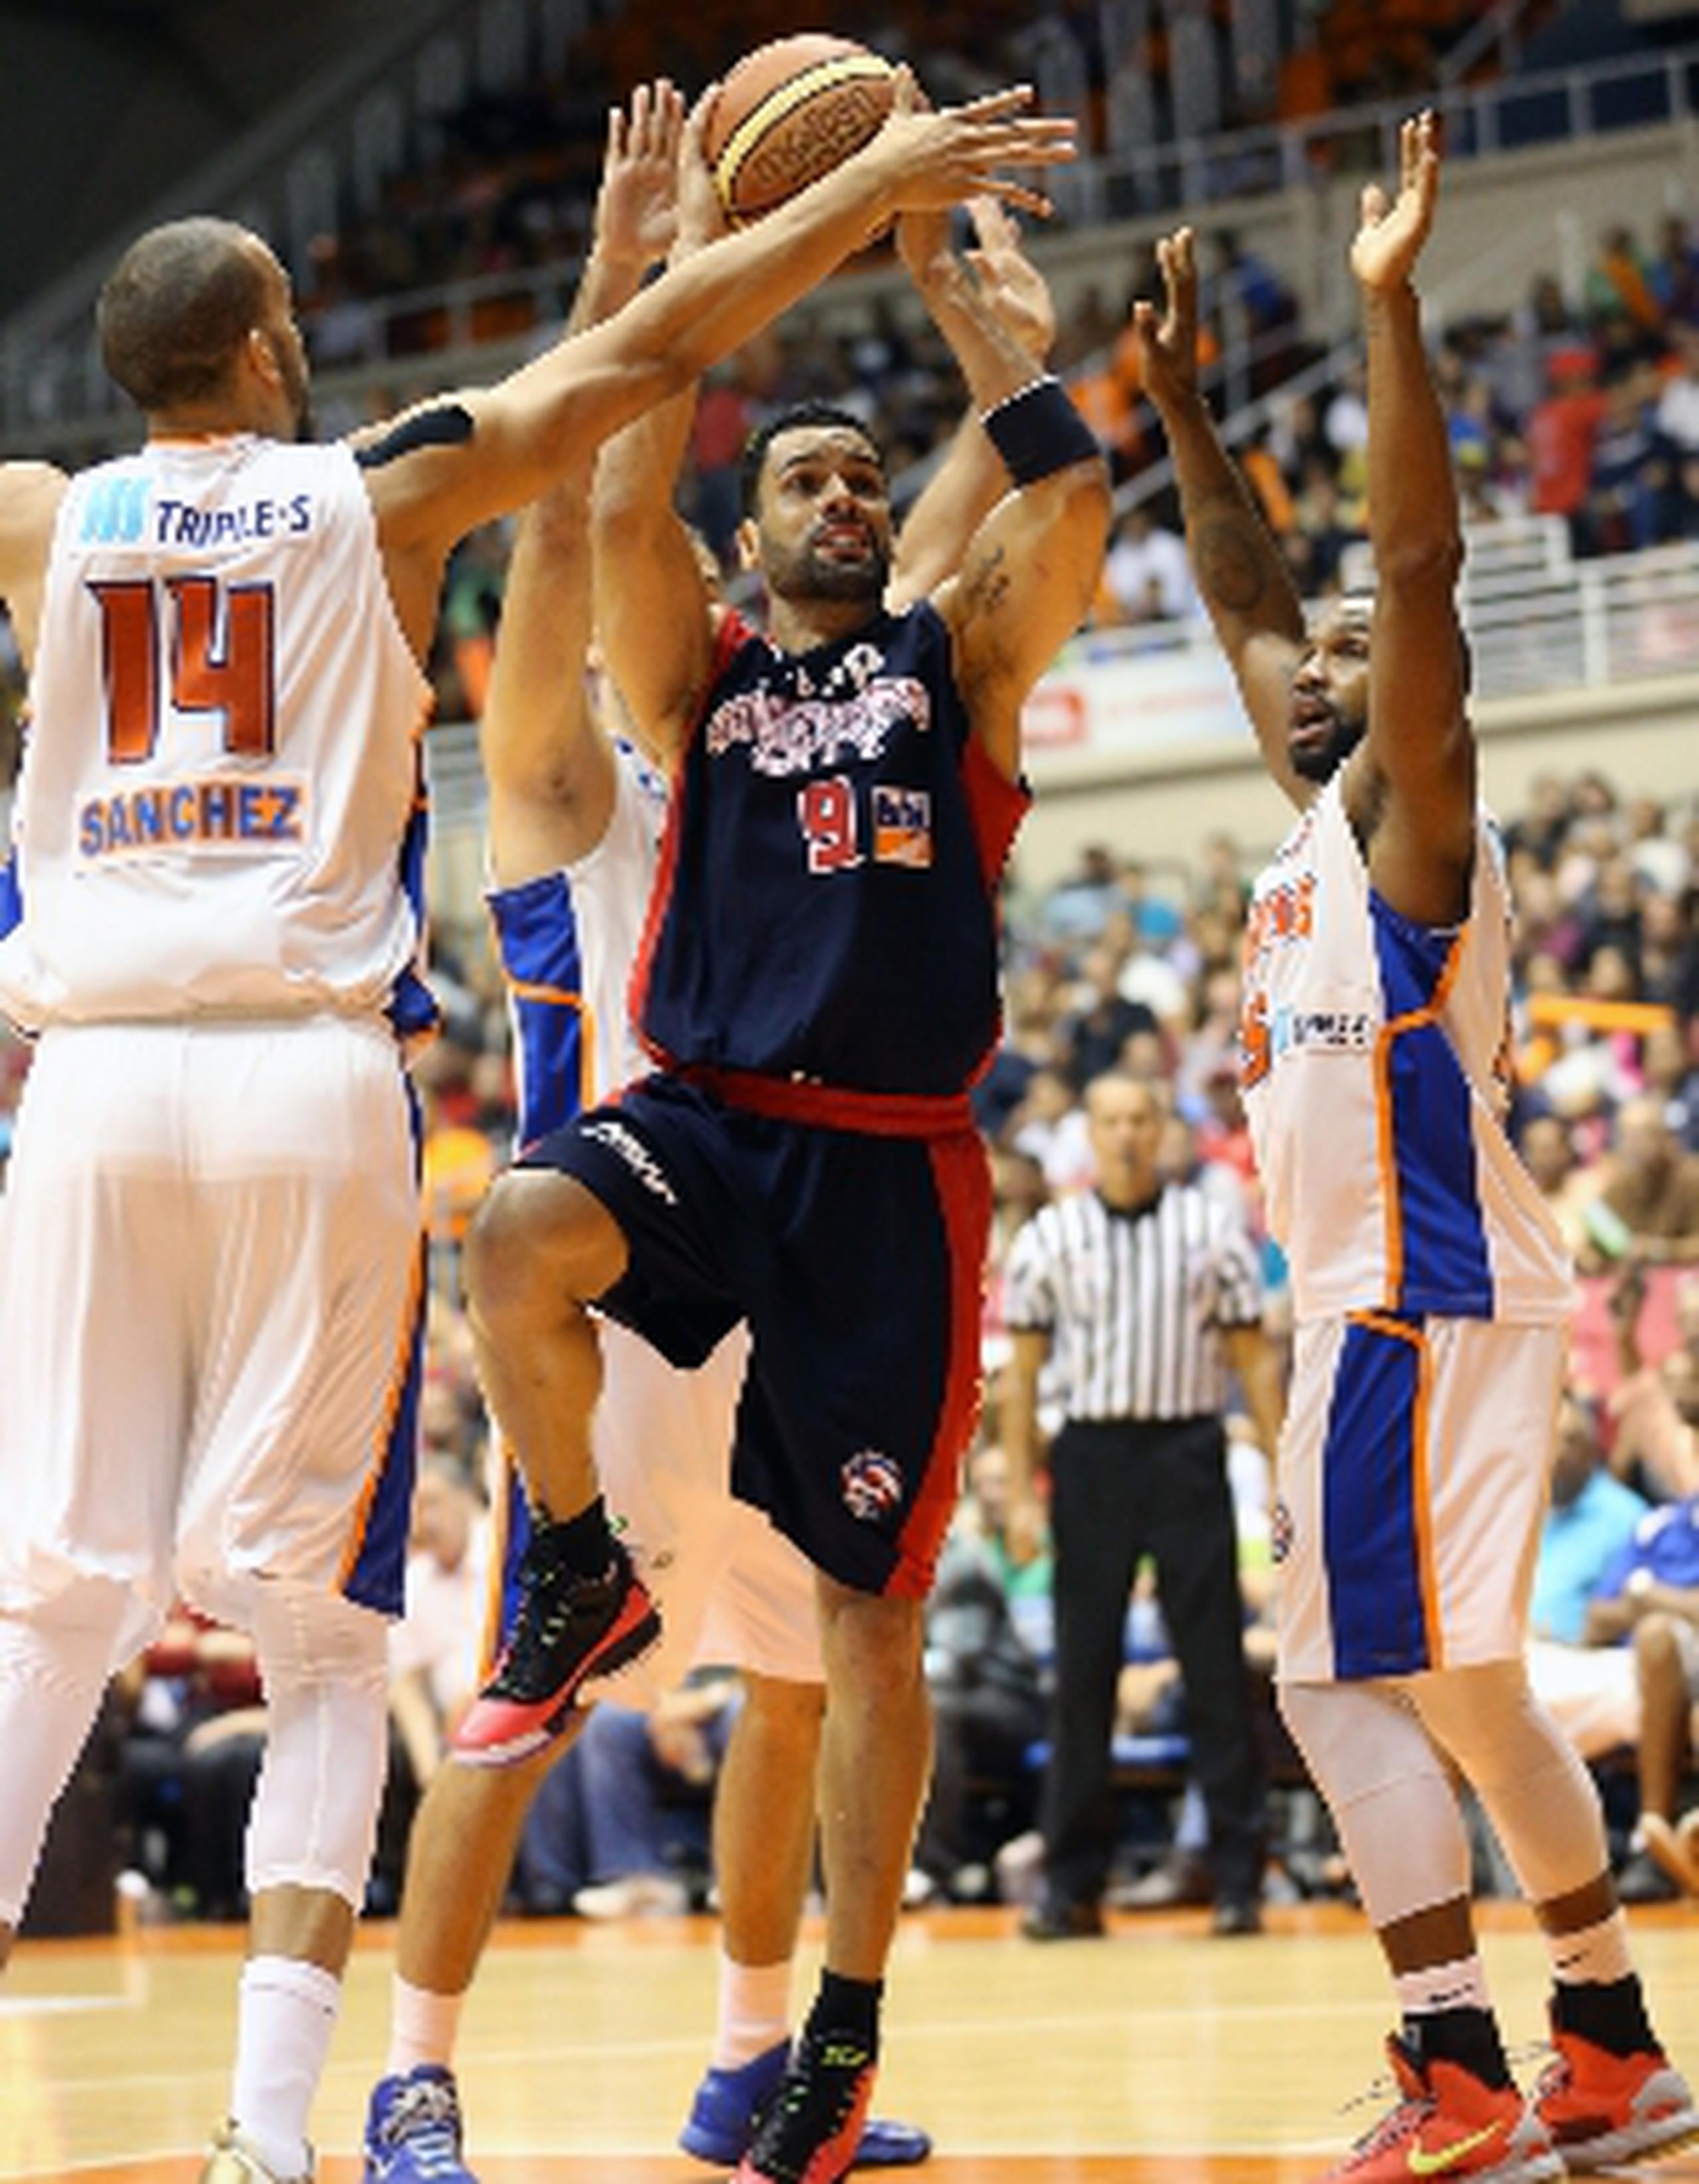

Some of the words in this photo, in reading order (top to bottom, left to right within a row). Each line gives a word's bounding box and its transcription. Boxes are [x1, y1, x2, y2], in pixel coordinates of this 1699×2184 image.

[85, 575, 275, 765] 14
[78, 782, 303, 856] SANCHEZ
[798, 775, 864, 874] 9
